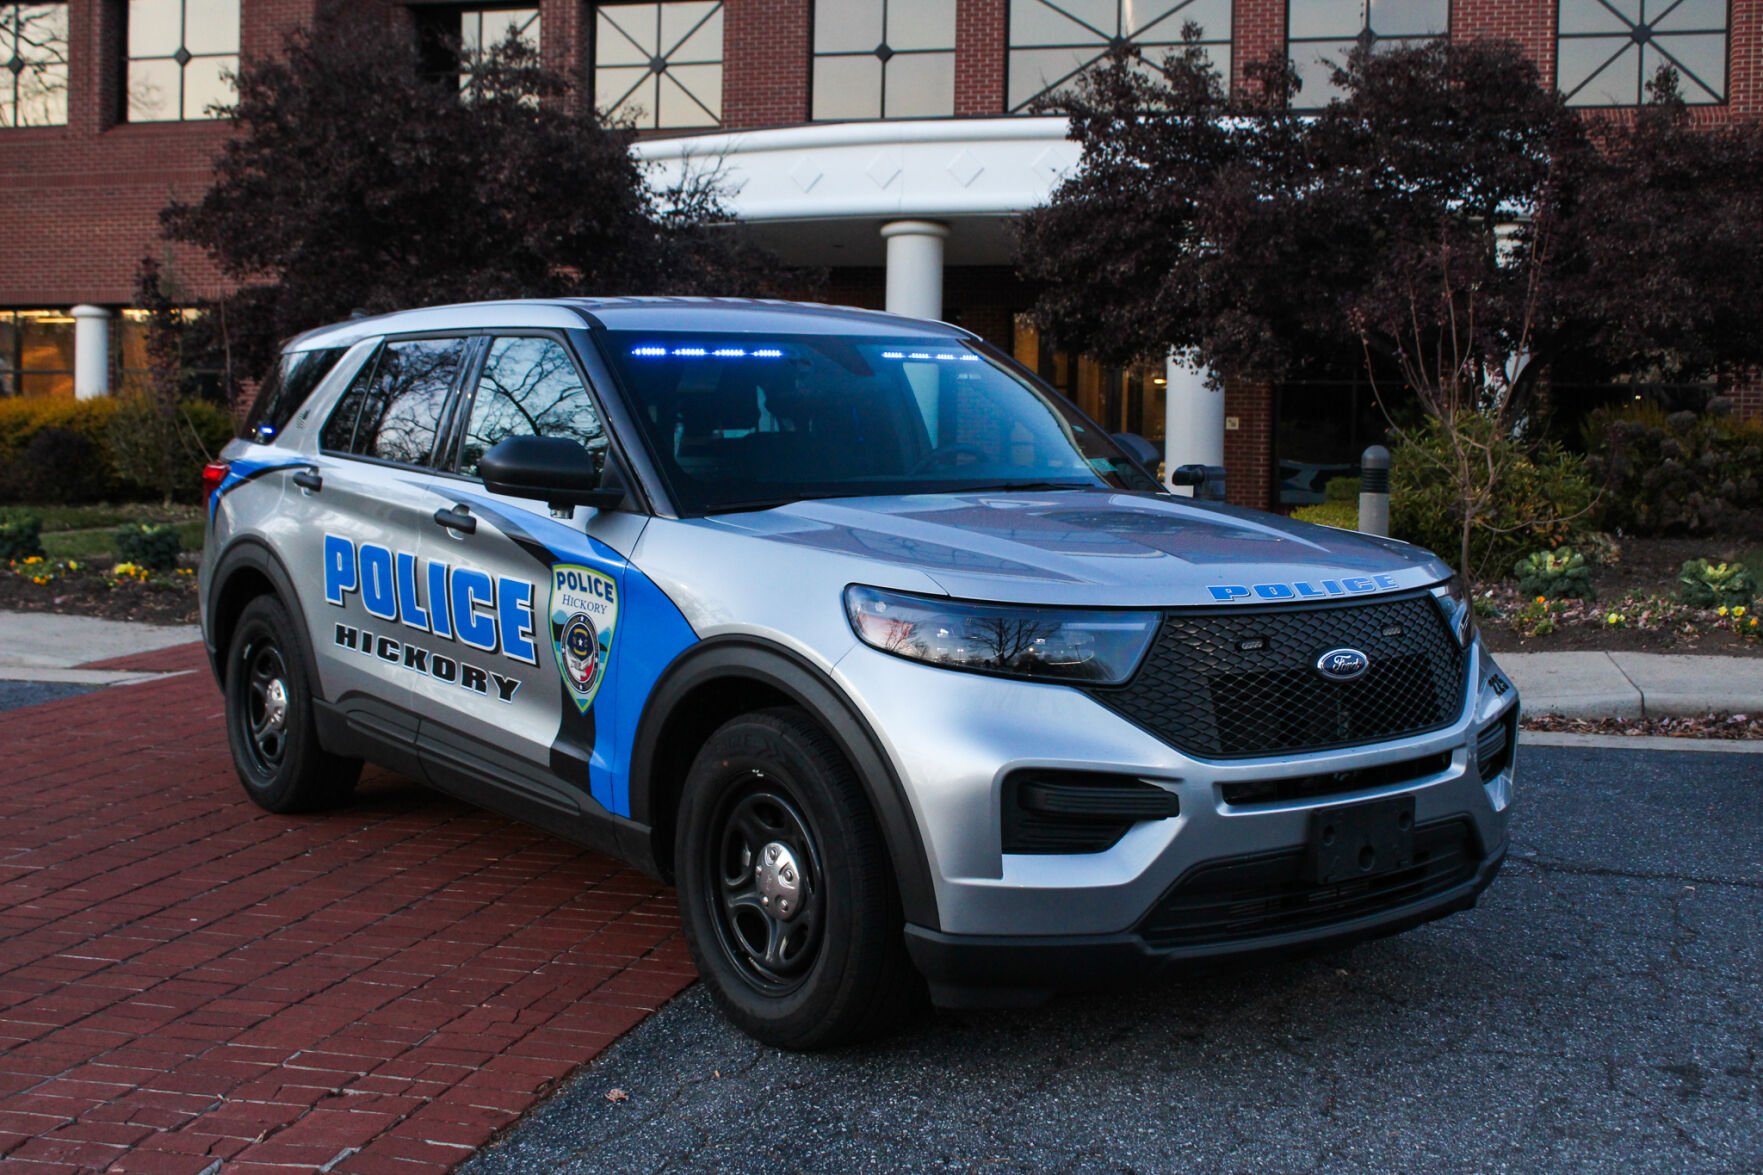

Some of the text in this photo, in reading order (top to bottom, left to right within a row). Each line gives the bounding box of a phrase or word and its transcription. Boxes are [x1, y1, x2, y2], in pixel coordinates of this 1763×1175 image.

[323, 533, 539, 667] POLICE
[556, 571, 615, 604] POLICE
[1205, 574, 1399, 602] POLICE
[561, 594, 608, 615] HICKORY
[334, 622, 521, 704] HICKORY
[1332, 655, 1362, 671] Ford
